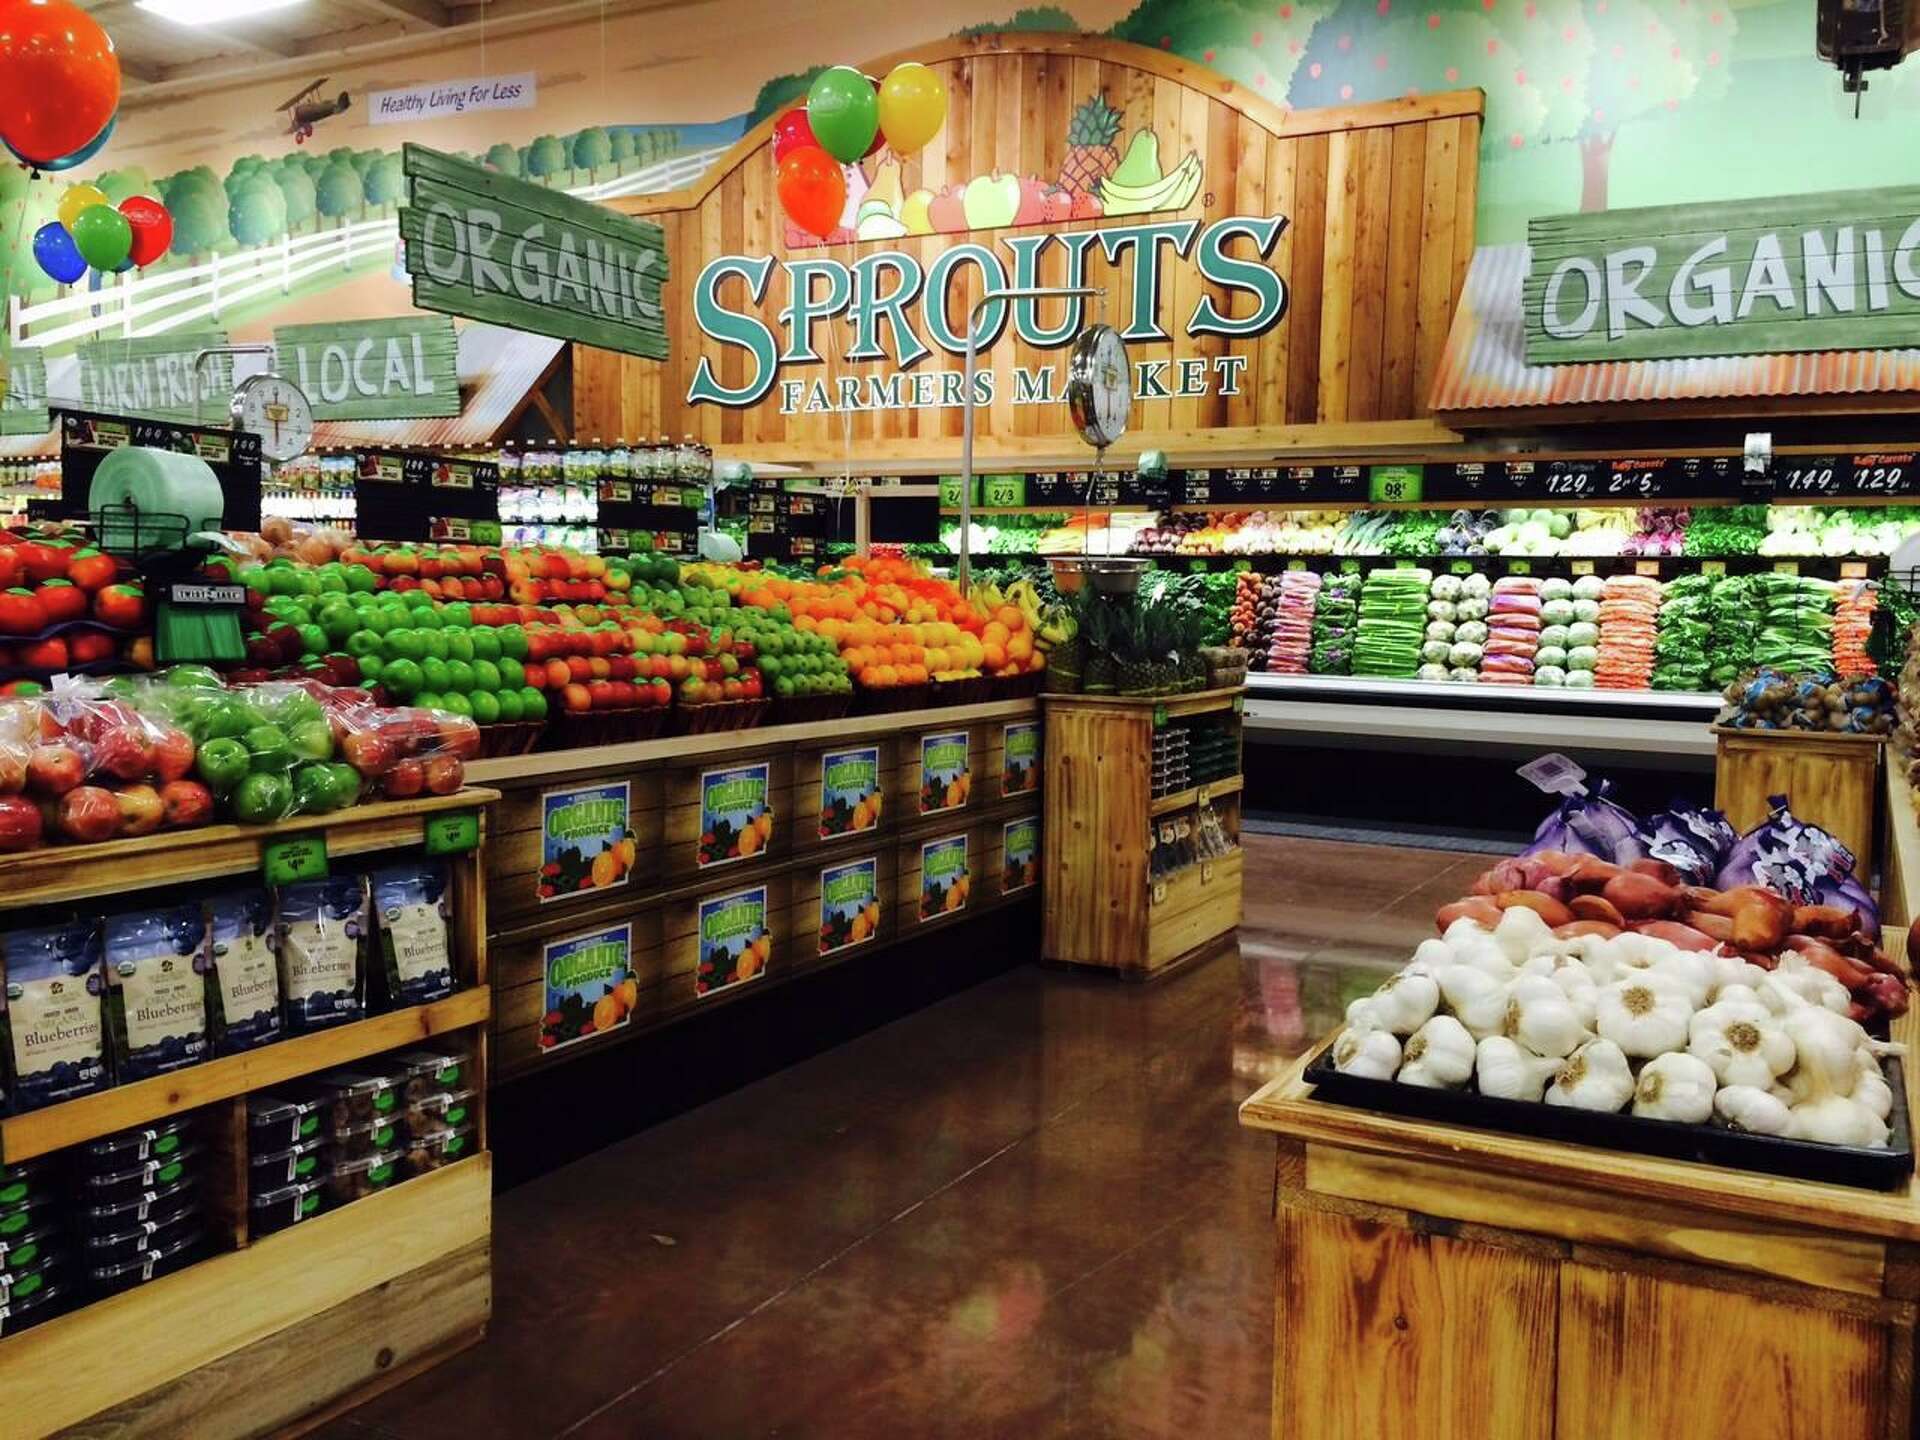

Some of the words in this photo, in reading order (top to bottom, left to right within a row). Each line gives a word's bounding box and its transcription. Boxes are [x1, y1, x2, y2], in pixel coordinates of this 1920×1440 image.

[380, 93, 425, 114] Healthy
[429, 90, 466, 111] Living
[469, 85, 490, 103] For
[492, 82, 523, 100] Less
[423, 202, 661, 318] ORGANIC
[689, 214, 1291, 407] SPROUTS
[296, 333, 435, 406] LOCAL
[779, 368, 997, 414] FARMERS
[1013, 355, 1249, 406] MKET
[548, 798, 625, 839] ORGANIC
[563, 824, 611, 841] PRODUCE
[550, 941, 626, 989] ORGANIC
[566, 967, 612, 988] PRODUCE
[24, 1022, 98, 1047] Blueberries
